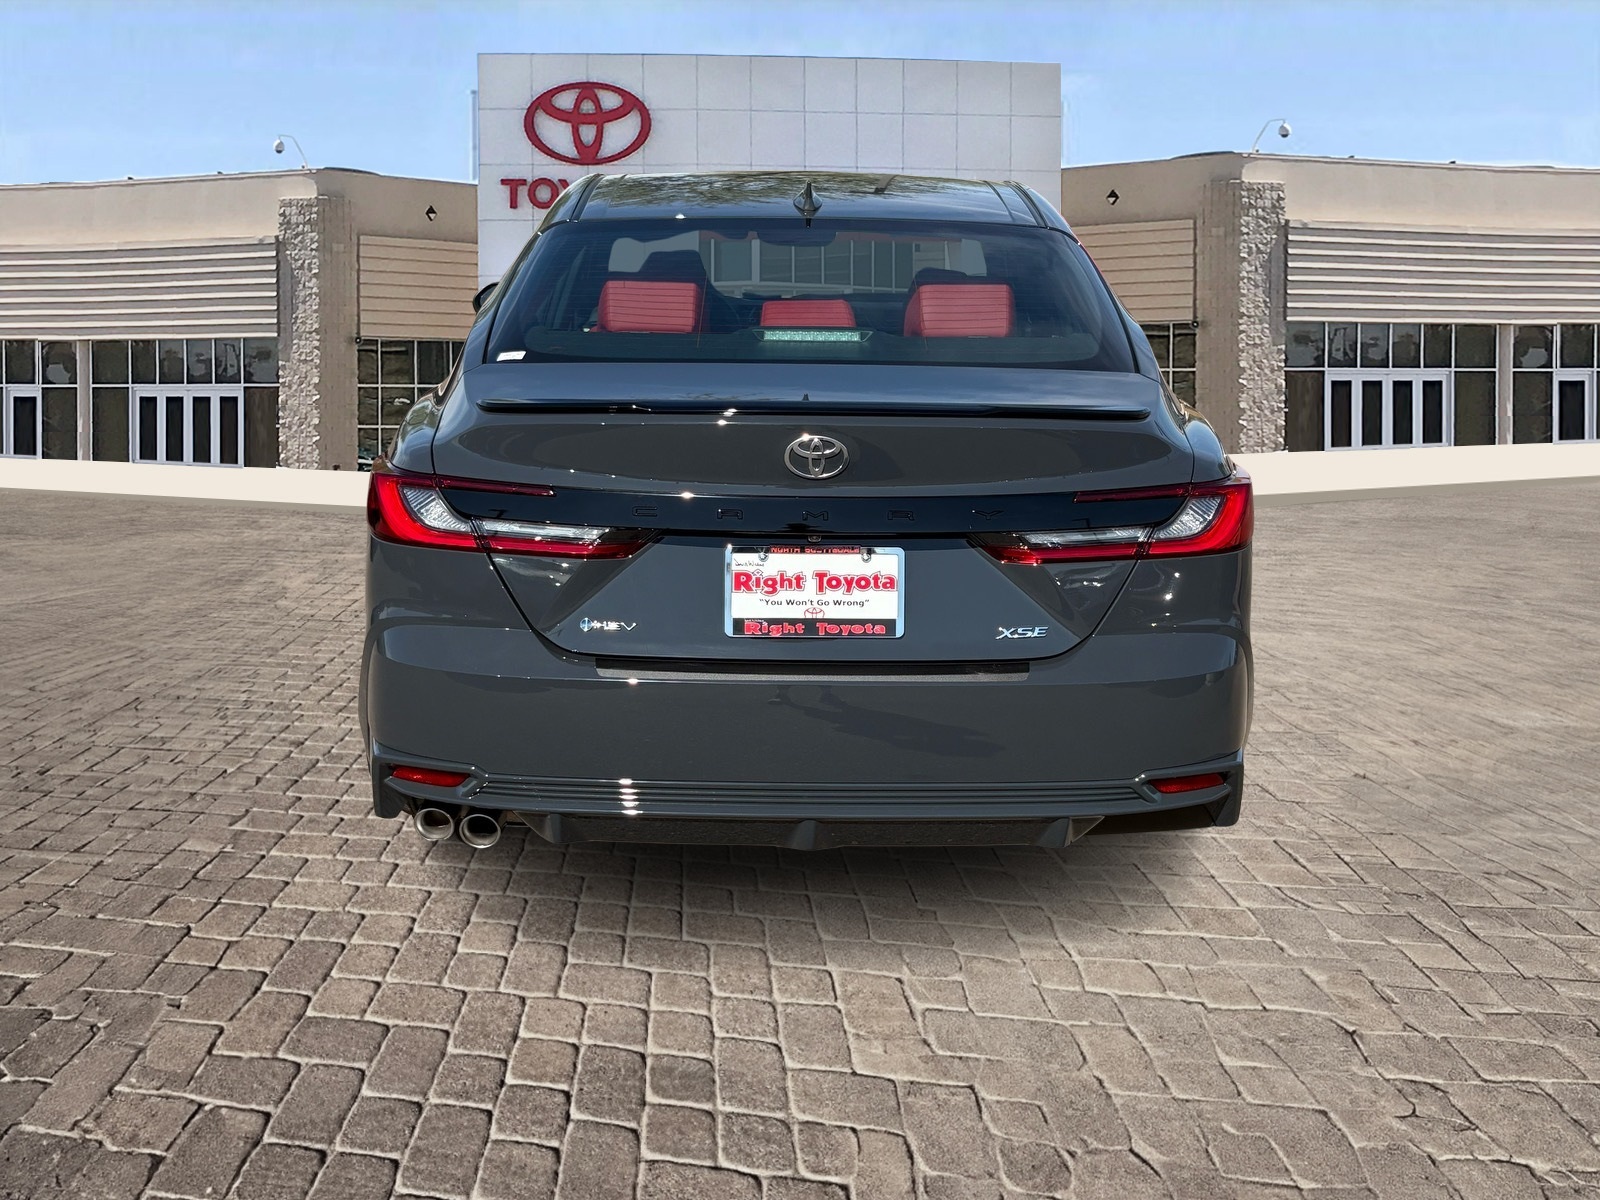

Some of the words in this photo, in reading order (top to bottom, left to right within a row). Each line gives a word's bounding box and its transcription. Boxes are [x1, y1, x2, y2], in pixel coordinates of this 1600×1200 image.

[632, 505, 1003, 521] CAMRY
[732, 569, 806, 596] Right
[813, 571, 898, 595] Toyota
[759, 599, 783, 607] "You
[786, 599, 815, 607] Won't
[817, 599, 830, 607] Go
[833, 599, 870, 608] Wrong"
[744, 622, 805, 636] Right
[816, 622, 886, 636] Toyota
[995, 626, 1049, 640] XSE
